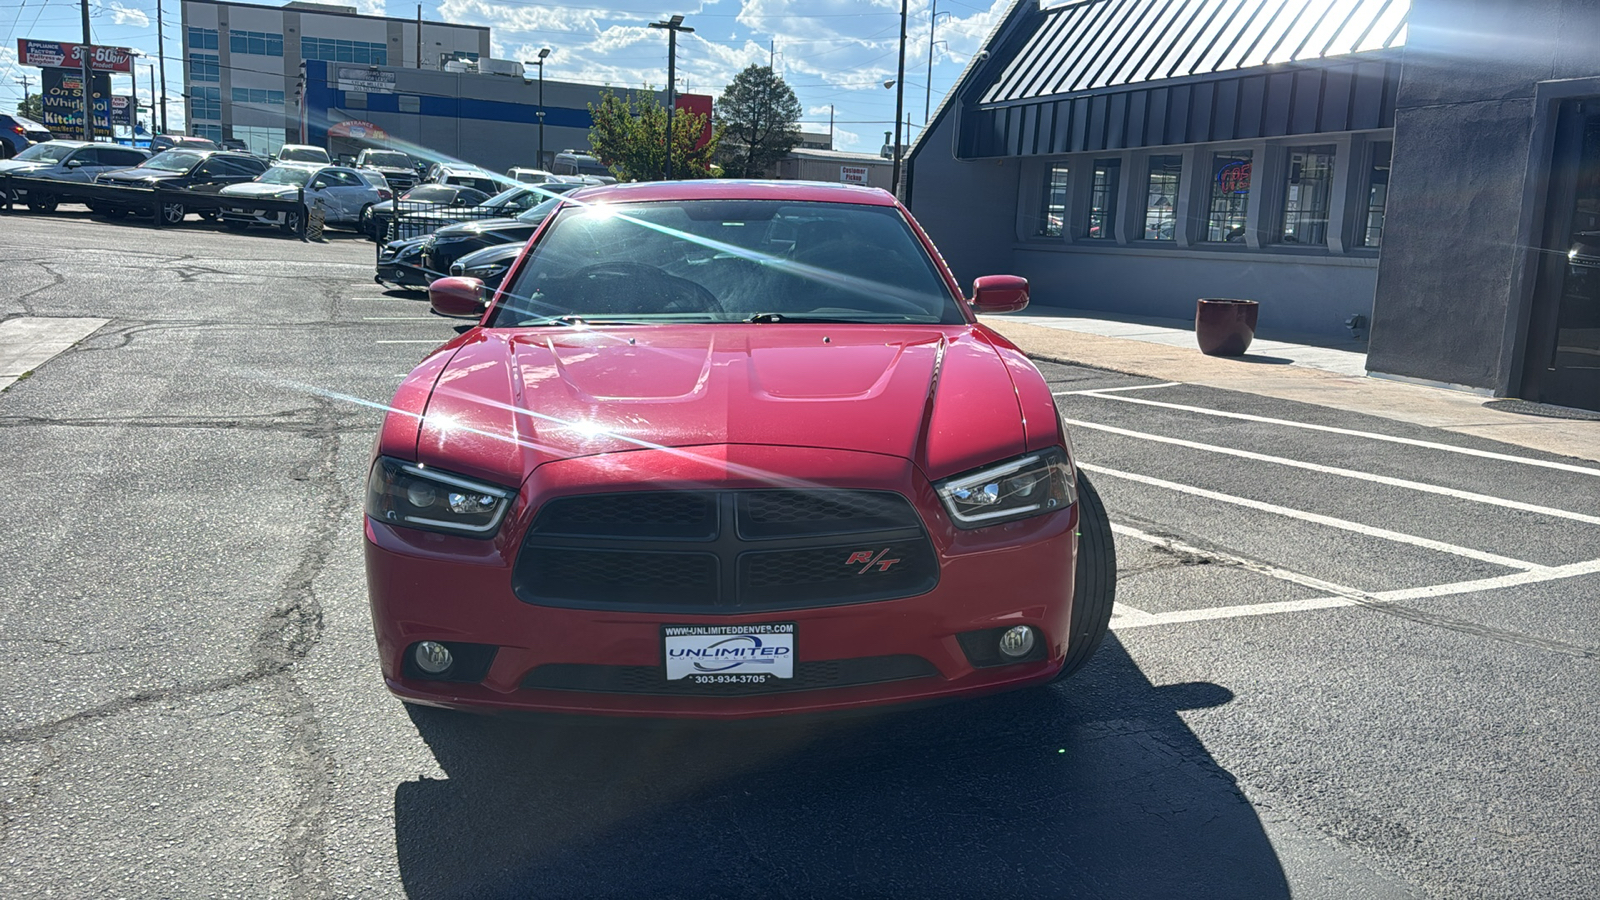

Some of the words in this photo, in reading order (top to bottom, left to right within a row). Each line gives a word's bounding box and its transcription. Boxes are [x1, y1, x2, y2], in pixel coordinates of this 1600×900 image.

[50, 87, 69, 96] On
[44, 96, 107, 112] Whirlol
[44, 111, 109, 127] KitcheAid
[342, 120, 374, 128] ENTRANCE
[842, 166, 866, 174] Customer
[845, 548, 900, 574] R/T
[669, 646, 790, 657] UNLIMITED
[695, 675, 766, 684] 303-934-3705
